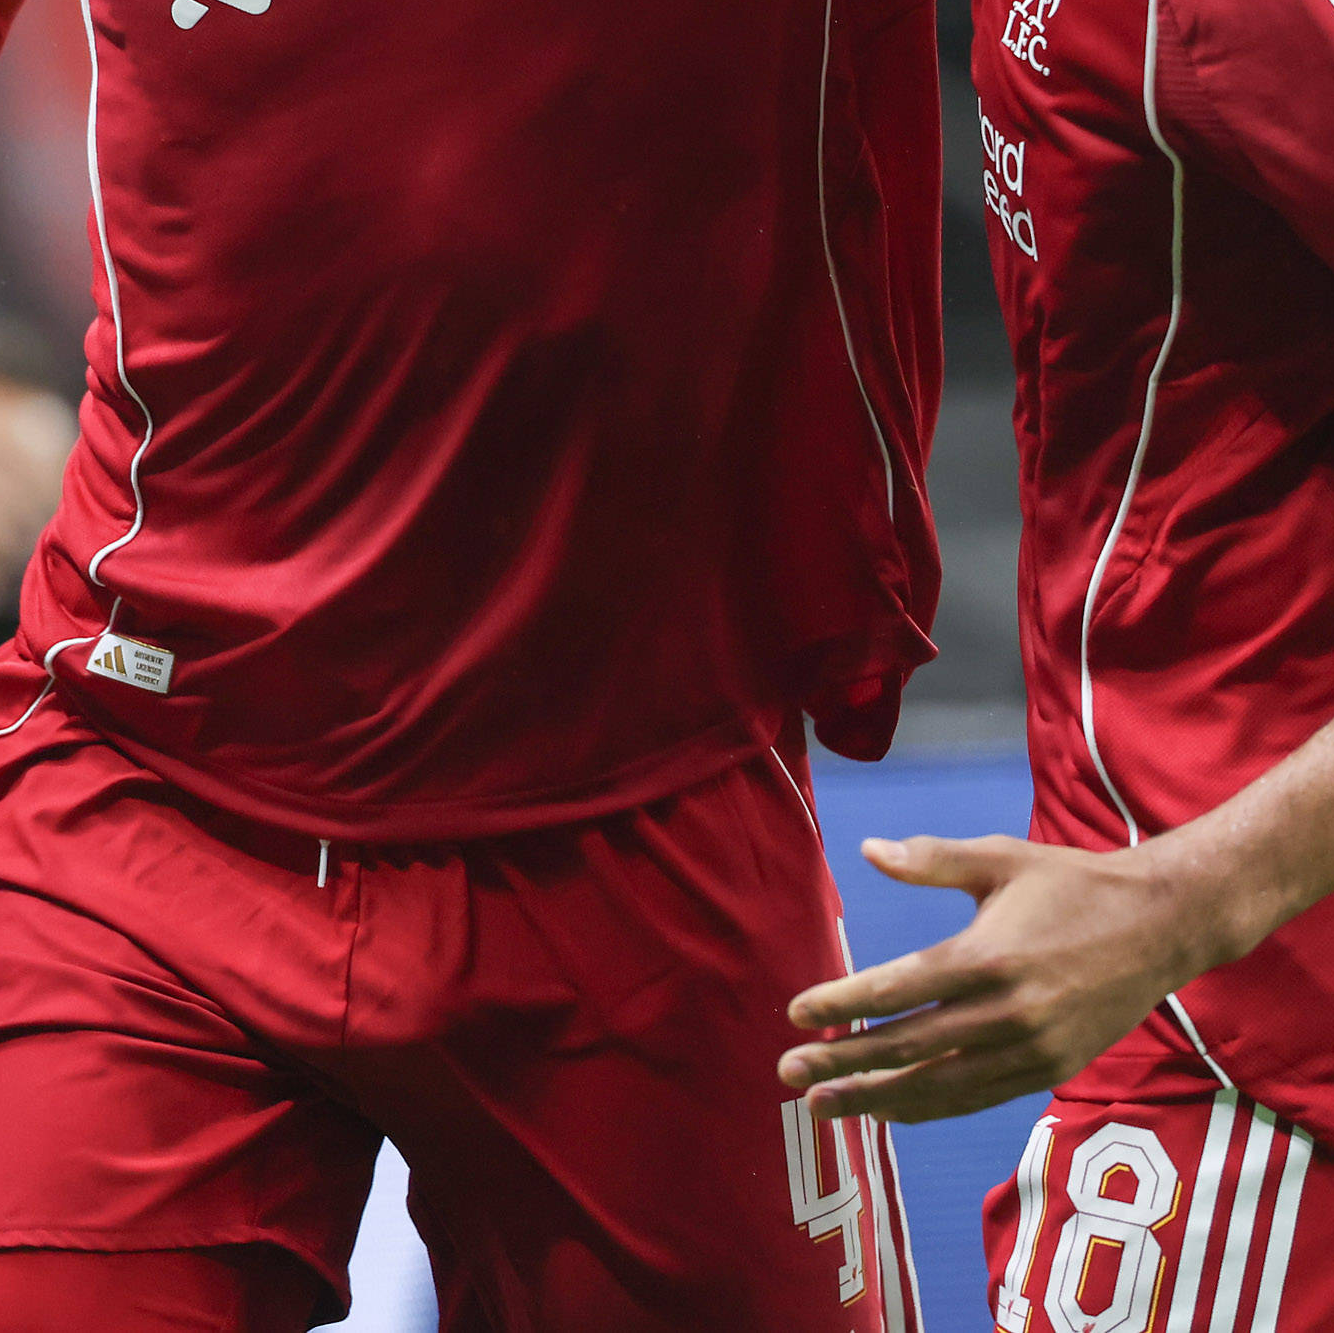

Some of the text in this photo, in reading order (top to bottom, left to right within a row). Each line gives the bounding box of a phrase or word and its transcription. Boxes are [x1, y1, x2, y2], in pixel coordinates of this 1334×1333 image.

[1000, 8, 1051, 77] L.F.C.
[781, 1095, 866, 1306] 4
[995, 1114, 1182, 1333] 18
